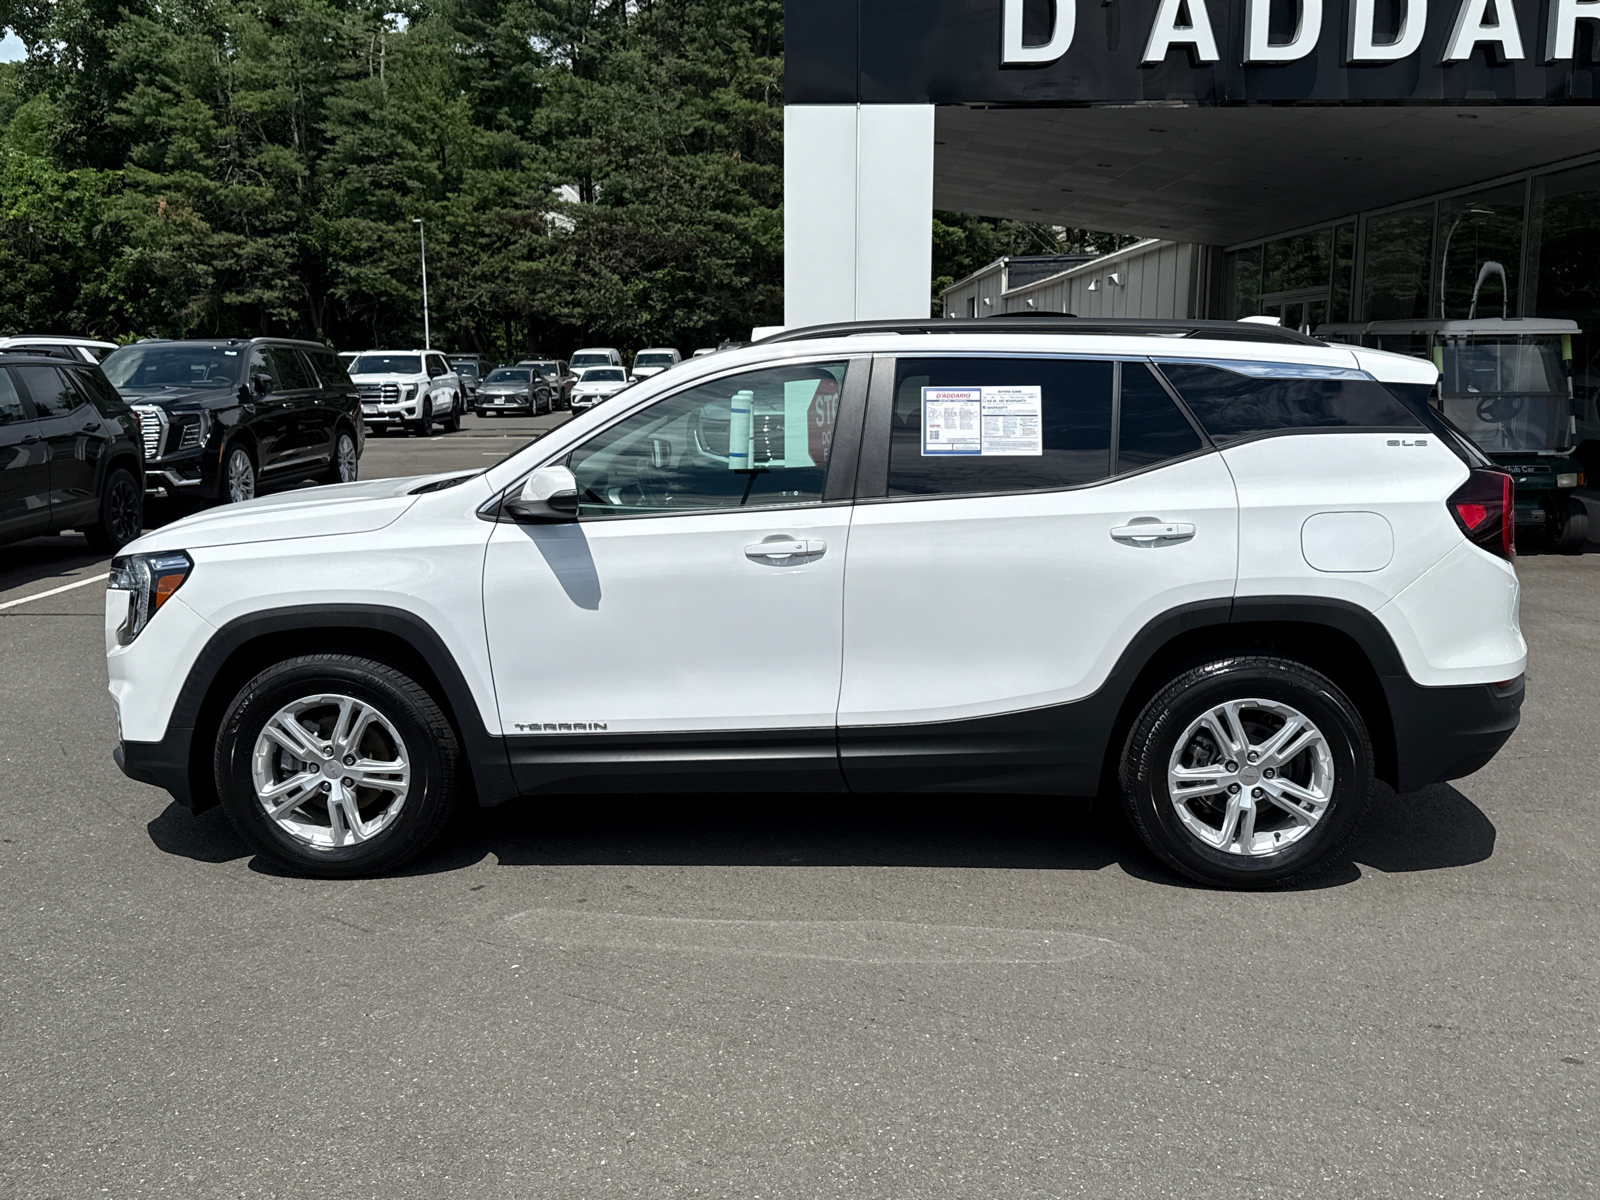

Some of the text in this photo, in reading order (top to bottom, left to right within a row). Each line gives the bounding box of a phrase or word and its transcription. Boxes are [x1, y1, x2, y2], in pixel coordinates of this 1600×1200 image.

[1521, 465, 1535, 473] Car
[515, 723, 607, 731] TERRAIN
[1137, 708, 1171, 782] BRIDGESTONE
